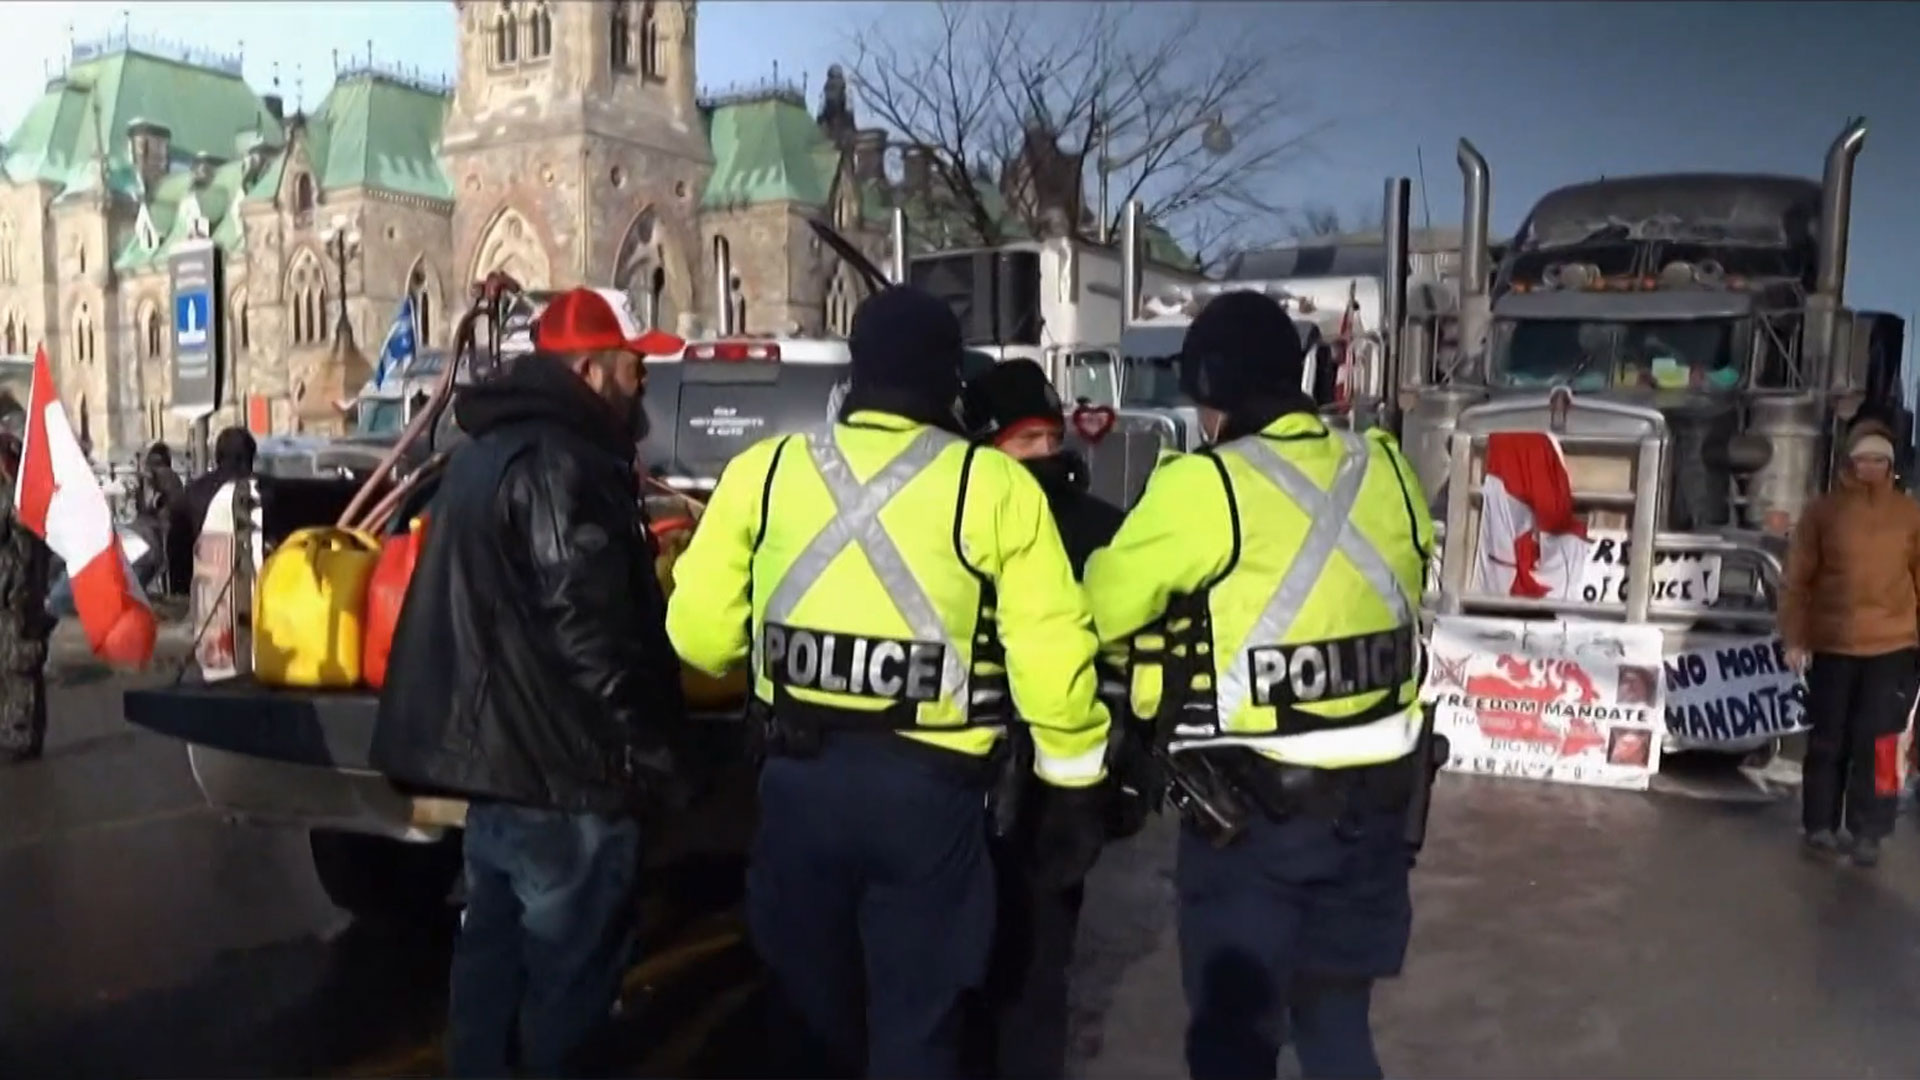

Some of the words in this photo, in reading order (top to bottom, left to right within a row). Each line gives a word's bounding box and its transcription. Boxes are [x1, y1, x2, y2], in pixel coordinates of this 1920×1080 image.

[764, 624, 944, 698] POLICE
[1664, 654, 1707, 692] NO
[1716, 640, 1791, 682] MORE
[1437, 693, 1536, 713] FREEDOM
[1544, 703, 1648, 723] MANDATE
[1665, 683, 1813, 740] MANDATES
[1490, 737, 1522, 753] BIG
[1527, 739, 1556, 756] NO
